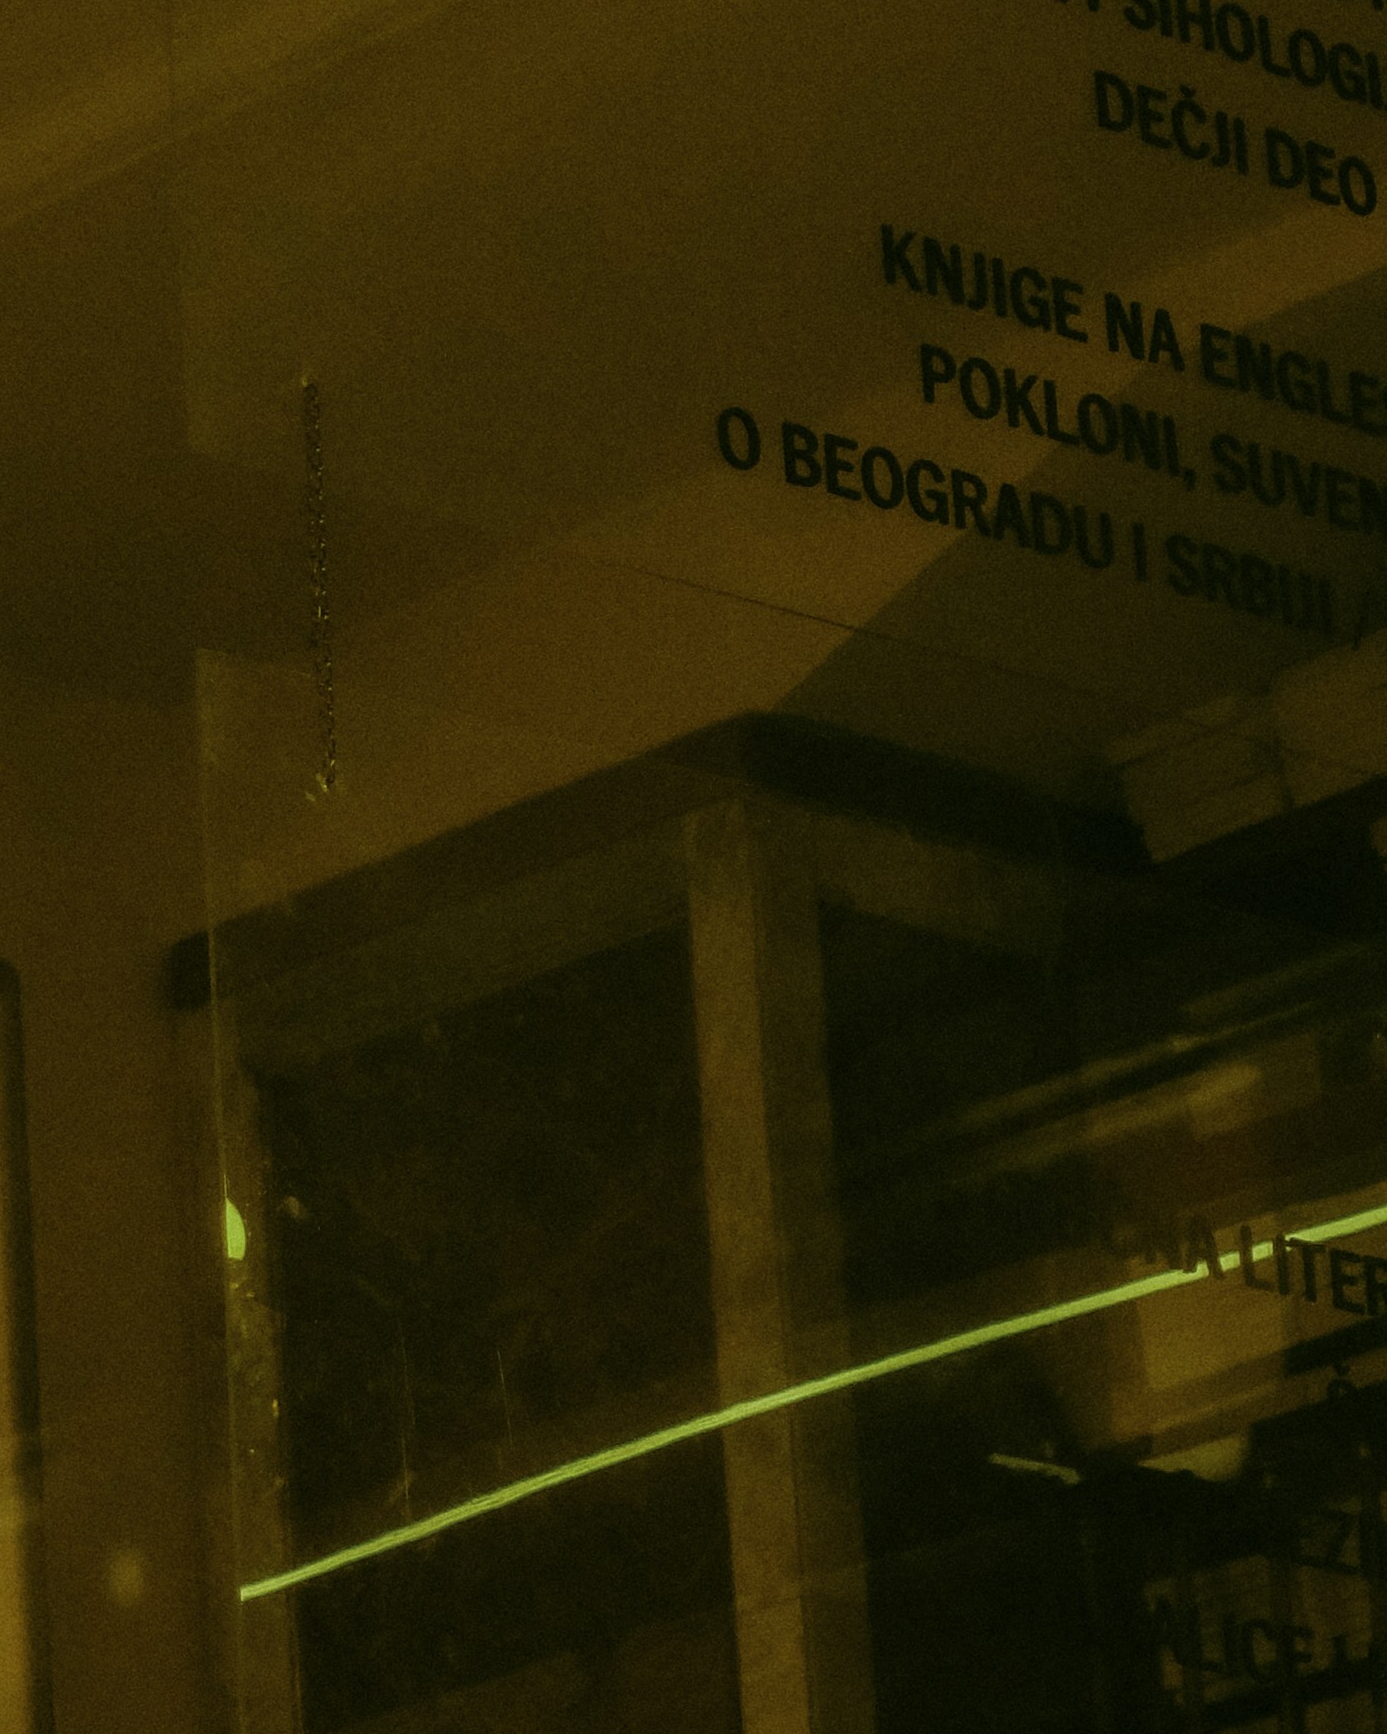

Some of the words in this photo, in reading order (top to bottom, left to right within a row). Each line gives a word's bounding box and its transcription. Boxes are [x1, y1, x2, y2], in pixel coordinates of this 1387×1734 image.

[1094, 70, 1250, 176] DEČJI
[1266, 126, 1379, 218] DEO
[880, 223, 1089, 343] KNJIGE
[1105, 290, 1186, 373] NA
[920, 342, 1196, 494] POKLONI,
[716, 404, 762, 471] O
[782, 420, 1115, 571] BEOGRADU
[1132, 521, 1148, 584] I
[1166, 529, 1337, 639] SRBIJI
